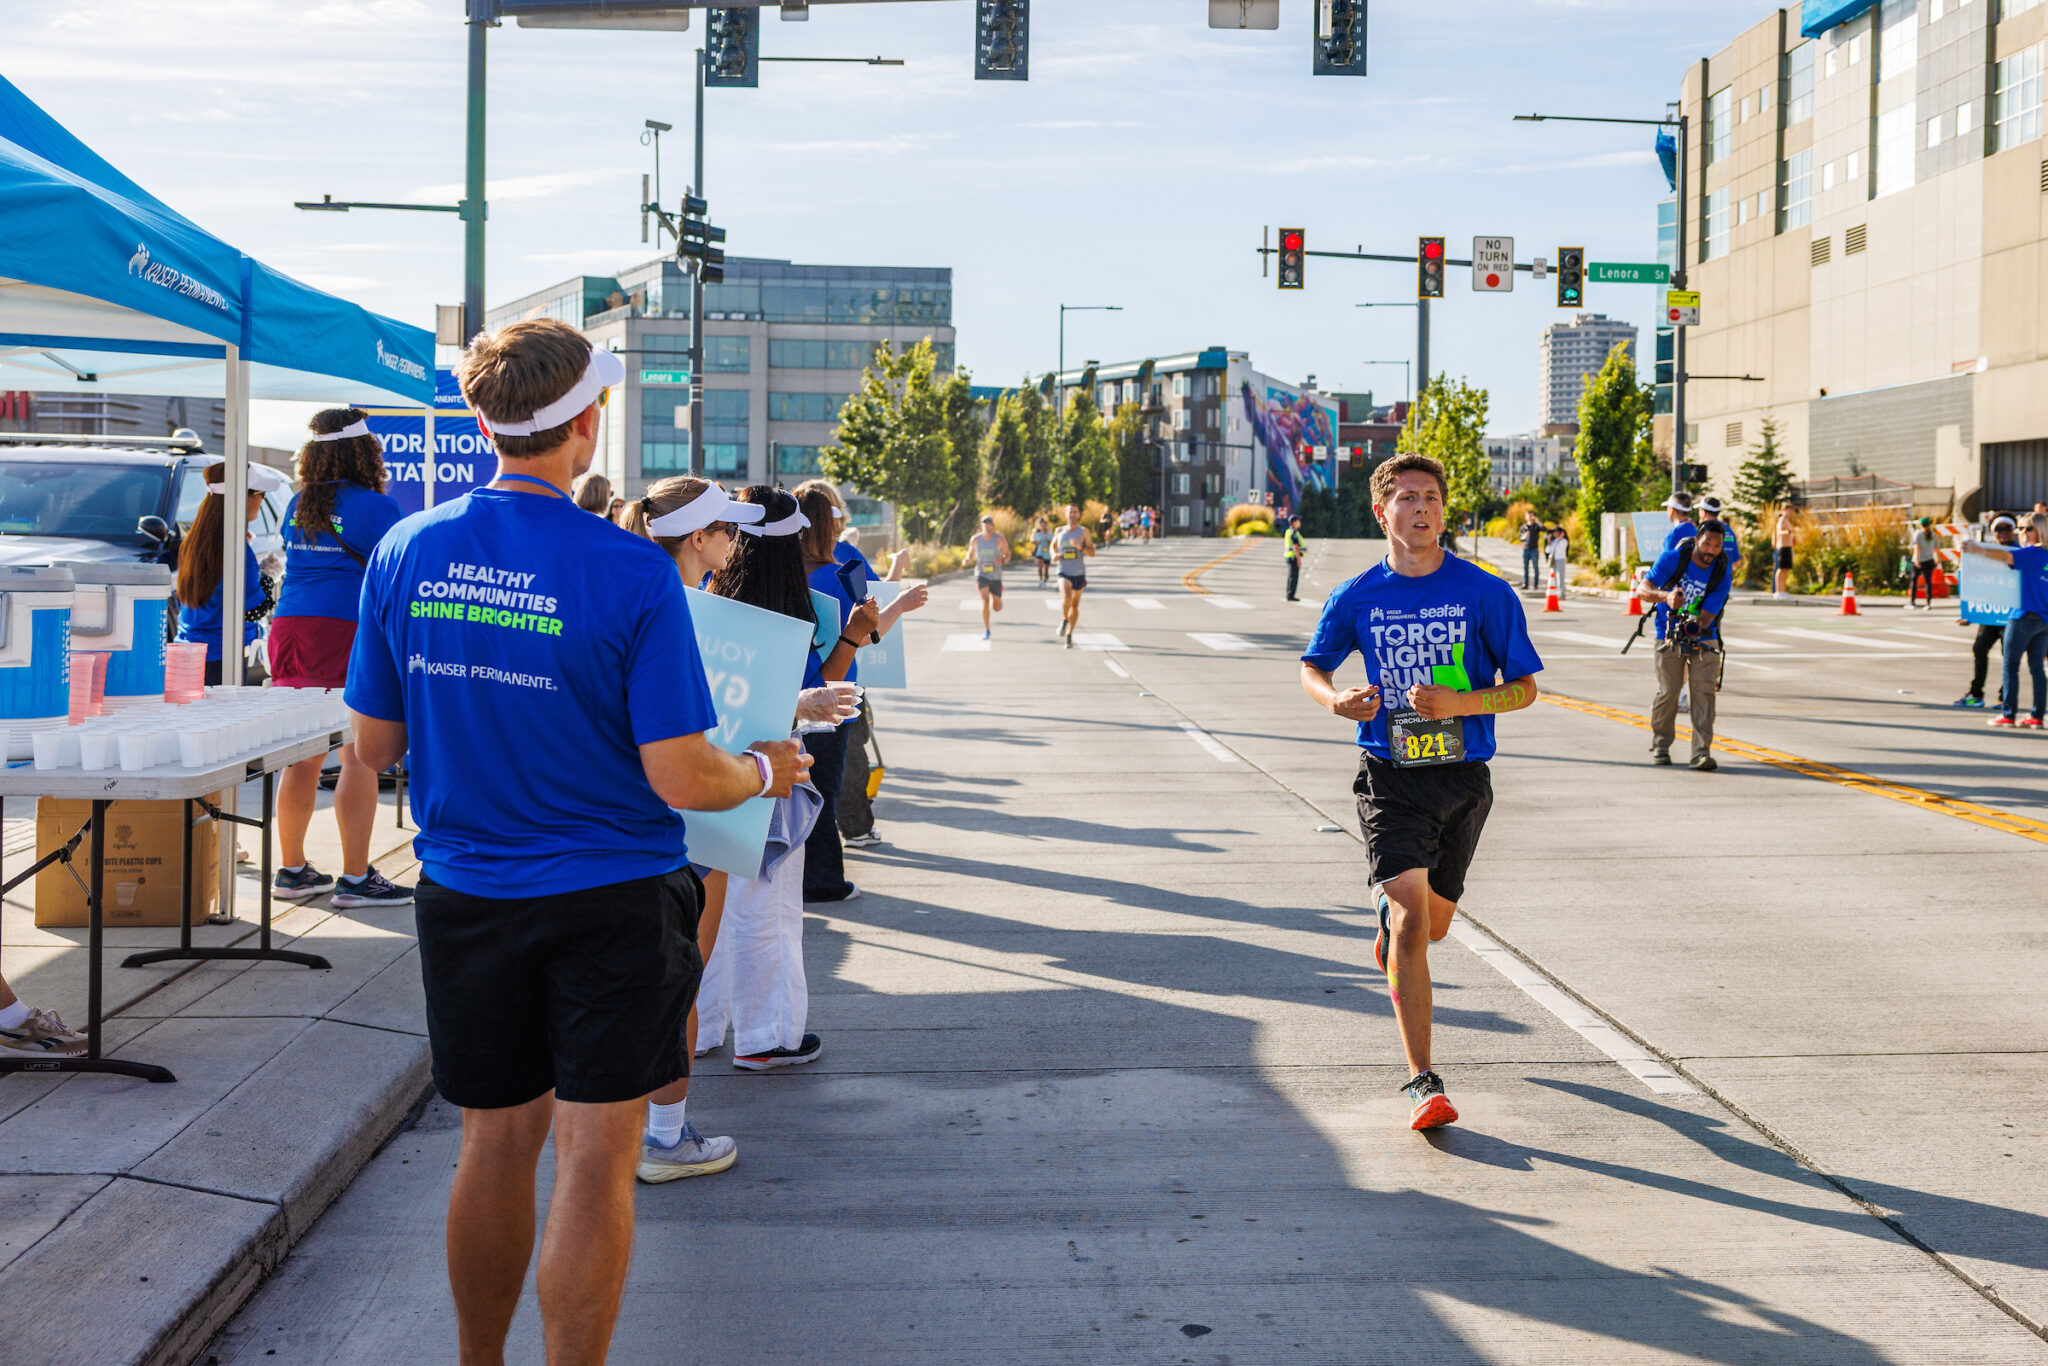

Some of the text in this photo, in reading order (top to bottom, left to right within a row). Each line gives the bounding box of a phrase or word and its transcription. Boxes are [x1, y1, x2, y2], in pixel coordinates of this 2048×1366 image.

[1486, 239, 1502, 250] NO
[1479, 251, 1509, 262] TURN
[1477, 263, 1510, 272] ON RED
[1600, 267, 1665, 280] Lenora St
[643, 372, 673, 383] Lenora
[376, 433, 493, 454] YDRTION
[383, 462, 474, 483] STATON
[447, 562, 536, 590] HEALTHY
[418, 581, 558, 614] COMMUNITIES
[410, 601, 564, 637] SHINE BRIGHTER
[1420, 604, 1466, 619] seafair
[1370, 621, 1467, 647] TORCH
[1375, 643, 1452, 669] LIGHT
[427, 662, 467, 678] KAISER
[1380, 666, 1433, 691] RUN
[1383, 688, 1412, 710] 5K
[1481, 685, 1525, 712] REED
[1406, 732, 1448, 760] 821
